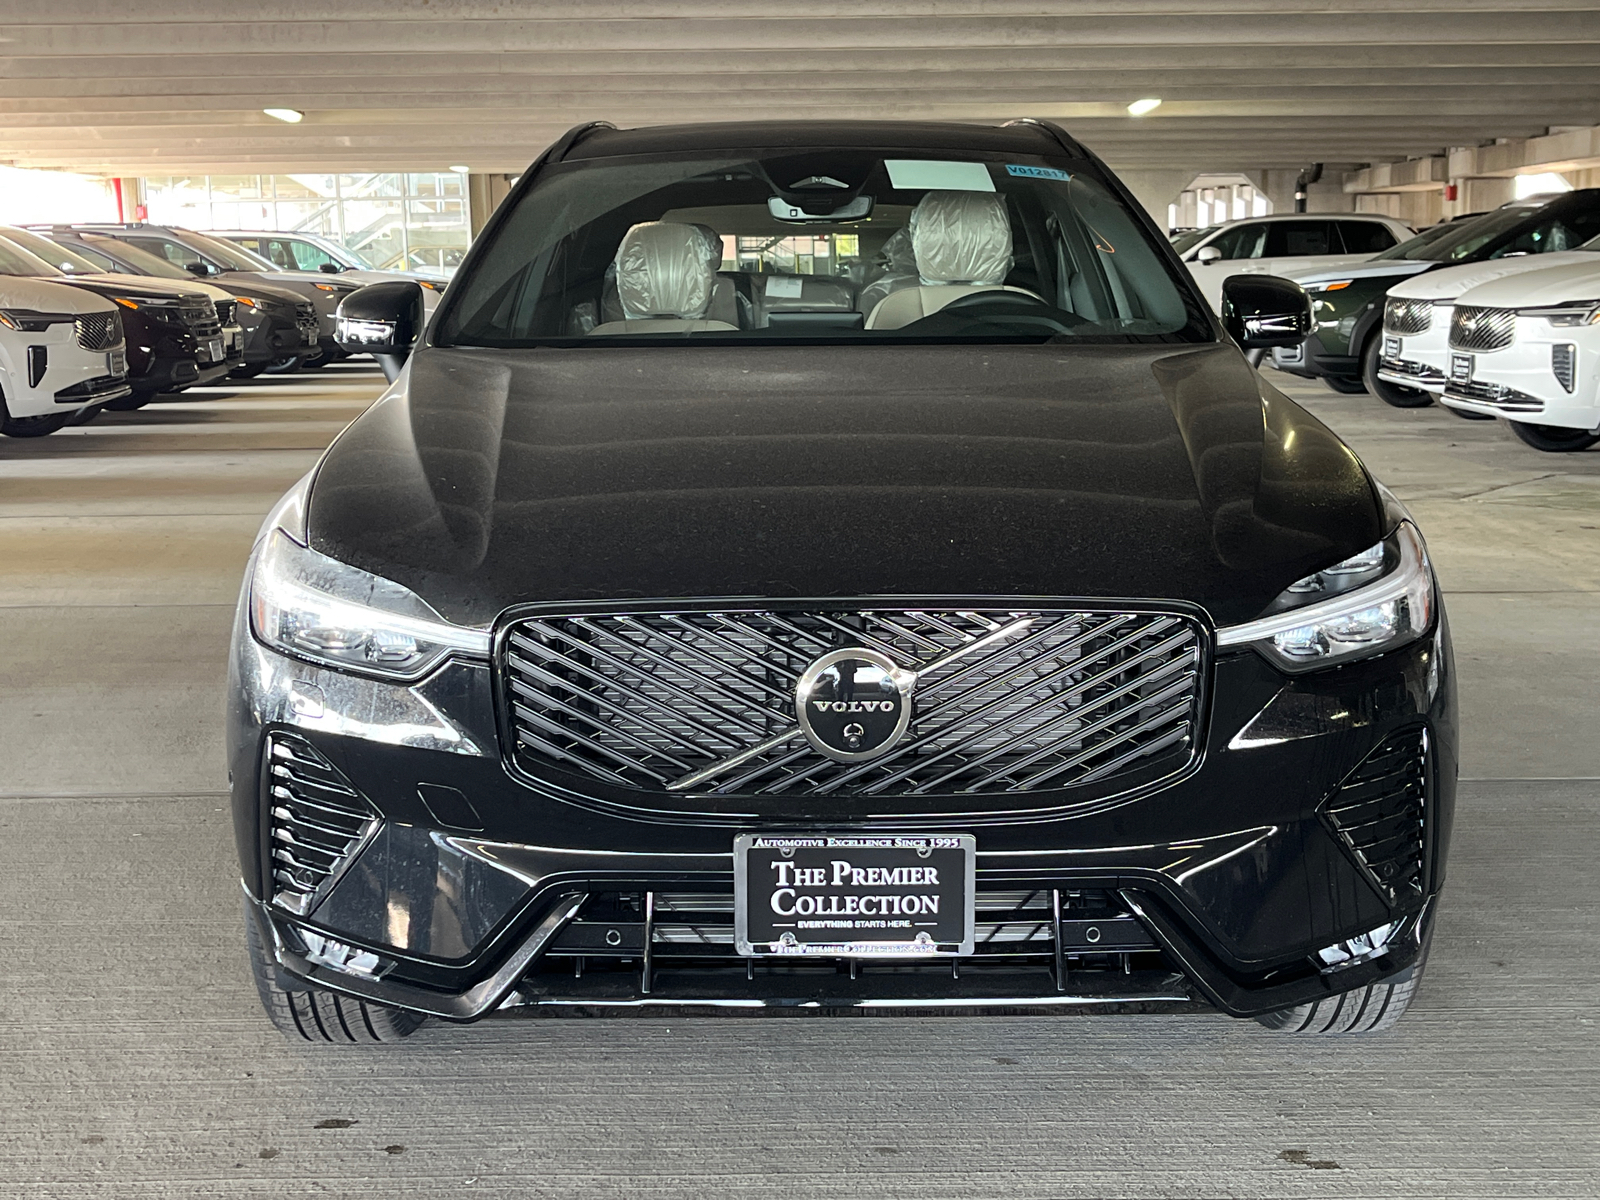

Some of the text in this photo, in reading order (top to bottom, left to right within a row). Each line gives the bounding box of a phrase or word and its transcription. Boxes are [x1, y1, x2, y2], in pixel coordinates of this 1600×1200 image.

[812, 701, 895, 712] VOLVO
[755, 838, 959, 848] AUTOMOTIVE EXCELLENCE SINCE 1995
[771, 861, 939, 886] THE PREMIER
[771, 888, 939, 915] COLLECTION
[797, 920, 912, 928] EVERYTHING STARTS HERE.
